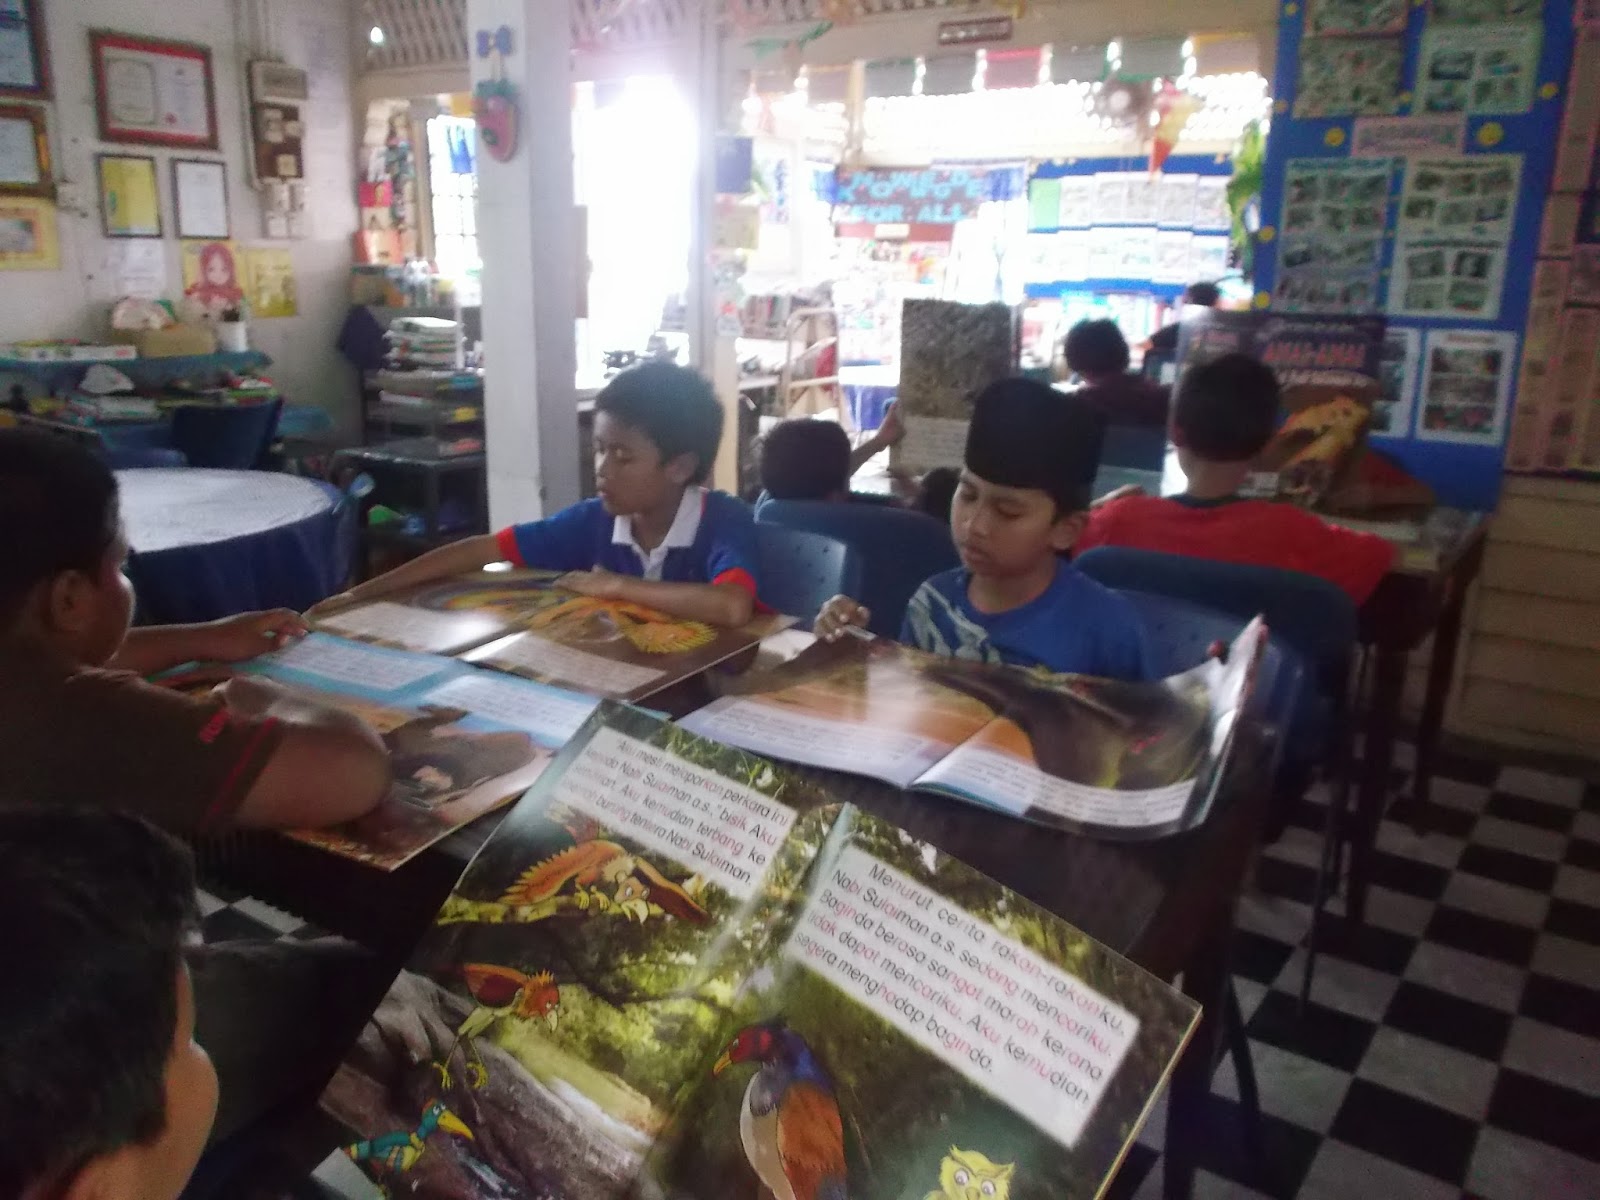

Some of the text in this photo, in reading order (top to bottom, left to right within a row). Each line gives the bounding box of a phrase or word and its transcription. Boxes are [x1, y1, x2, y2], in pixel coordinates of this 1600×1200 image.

[621, 783, 641, 800] Aku
[642, 794, 694, 828] kemudian
[696, 822, 745, 857] terbang
[747, 846, 766, 866] ke
[643, 772, 692, 803] Sulaiman
[719, 807, 749, 832] bisik
[749, 823, 778, 847] Aku
[663, 761, 723, 795] melaporkan
[722, 789, 771, 817] perkara
[771, 808, 789, 827] ini
[666, 829, 692, 851] Nabi
[794, 931, 993, 1073] segera menghadap baginda.
[807, 910, 1091, 1103] tidak dapat mencariku. Aku kemudian
[819, 888, 1103, 1082] Baginda berasa sangat marah kerana
[832, 869, 1113, 1057] Nabi Sulaiman a.s. sedang mencariku.
[868, 863, 1126, 1036] Menurut cerita rakan-rakanku.
